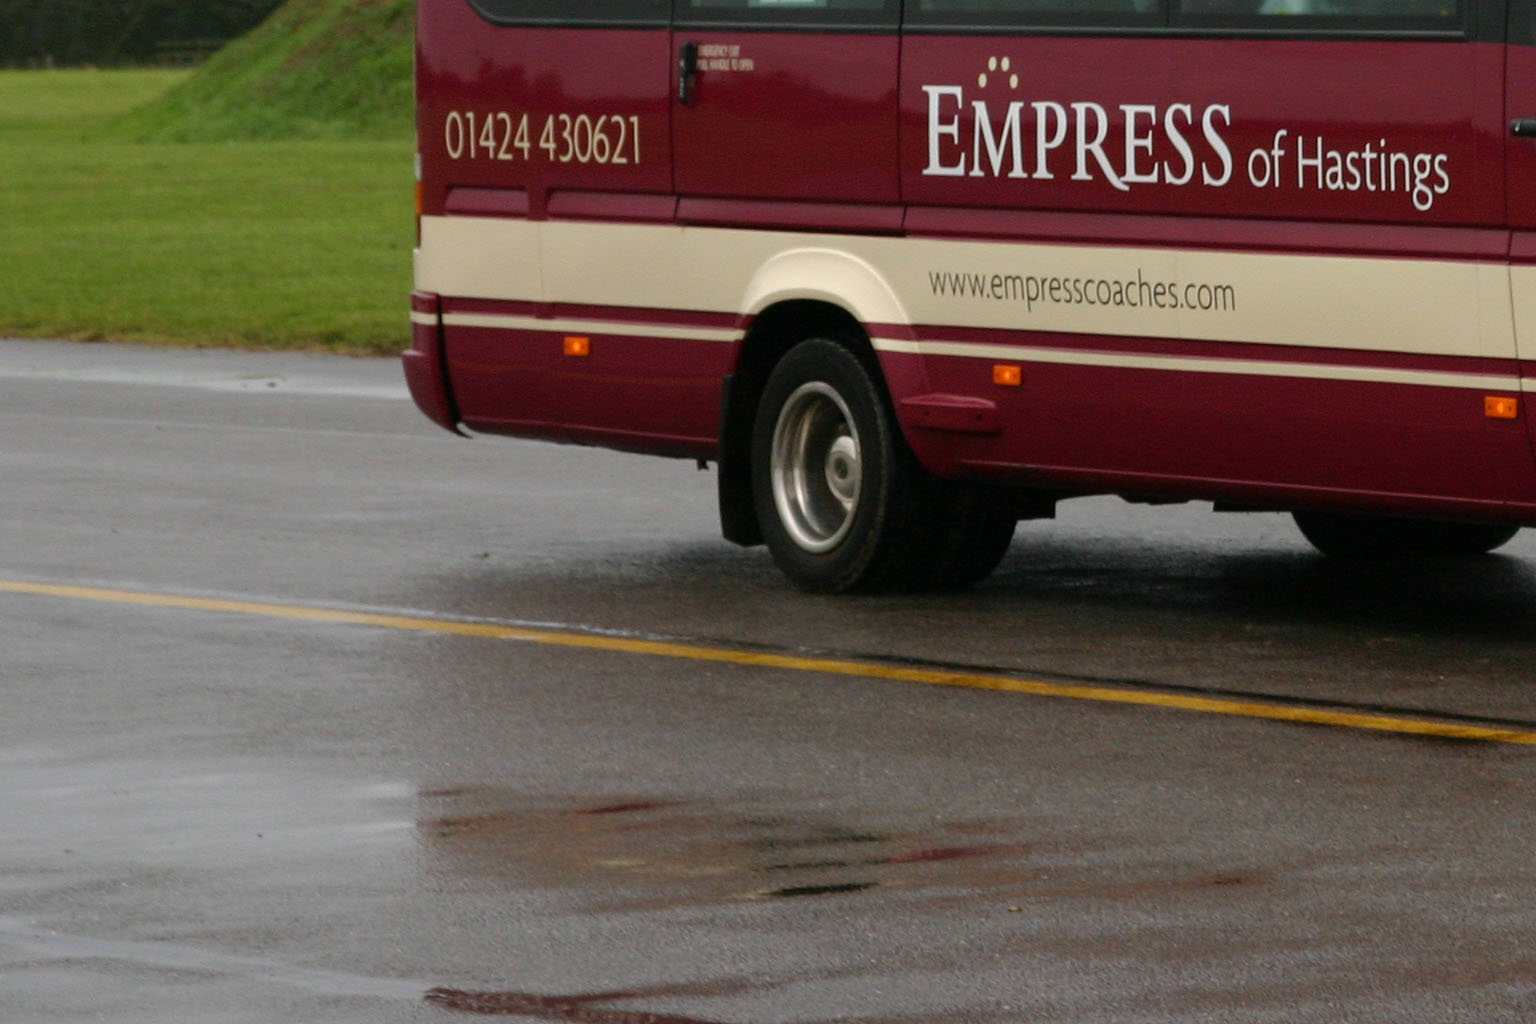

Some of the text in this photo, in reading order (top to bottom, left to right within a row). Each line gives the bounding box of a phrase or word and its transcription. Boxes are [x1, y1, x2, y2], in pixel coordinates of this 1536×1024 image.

[445, 110, 641, 165] 01424 430621
[921, 84, 1450, 212] EMPRESS of Hastings
[928, 268, 1236, 314] www.empresscoaches.com
